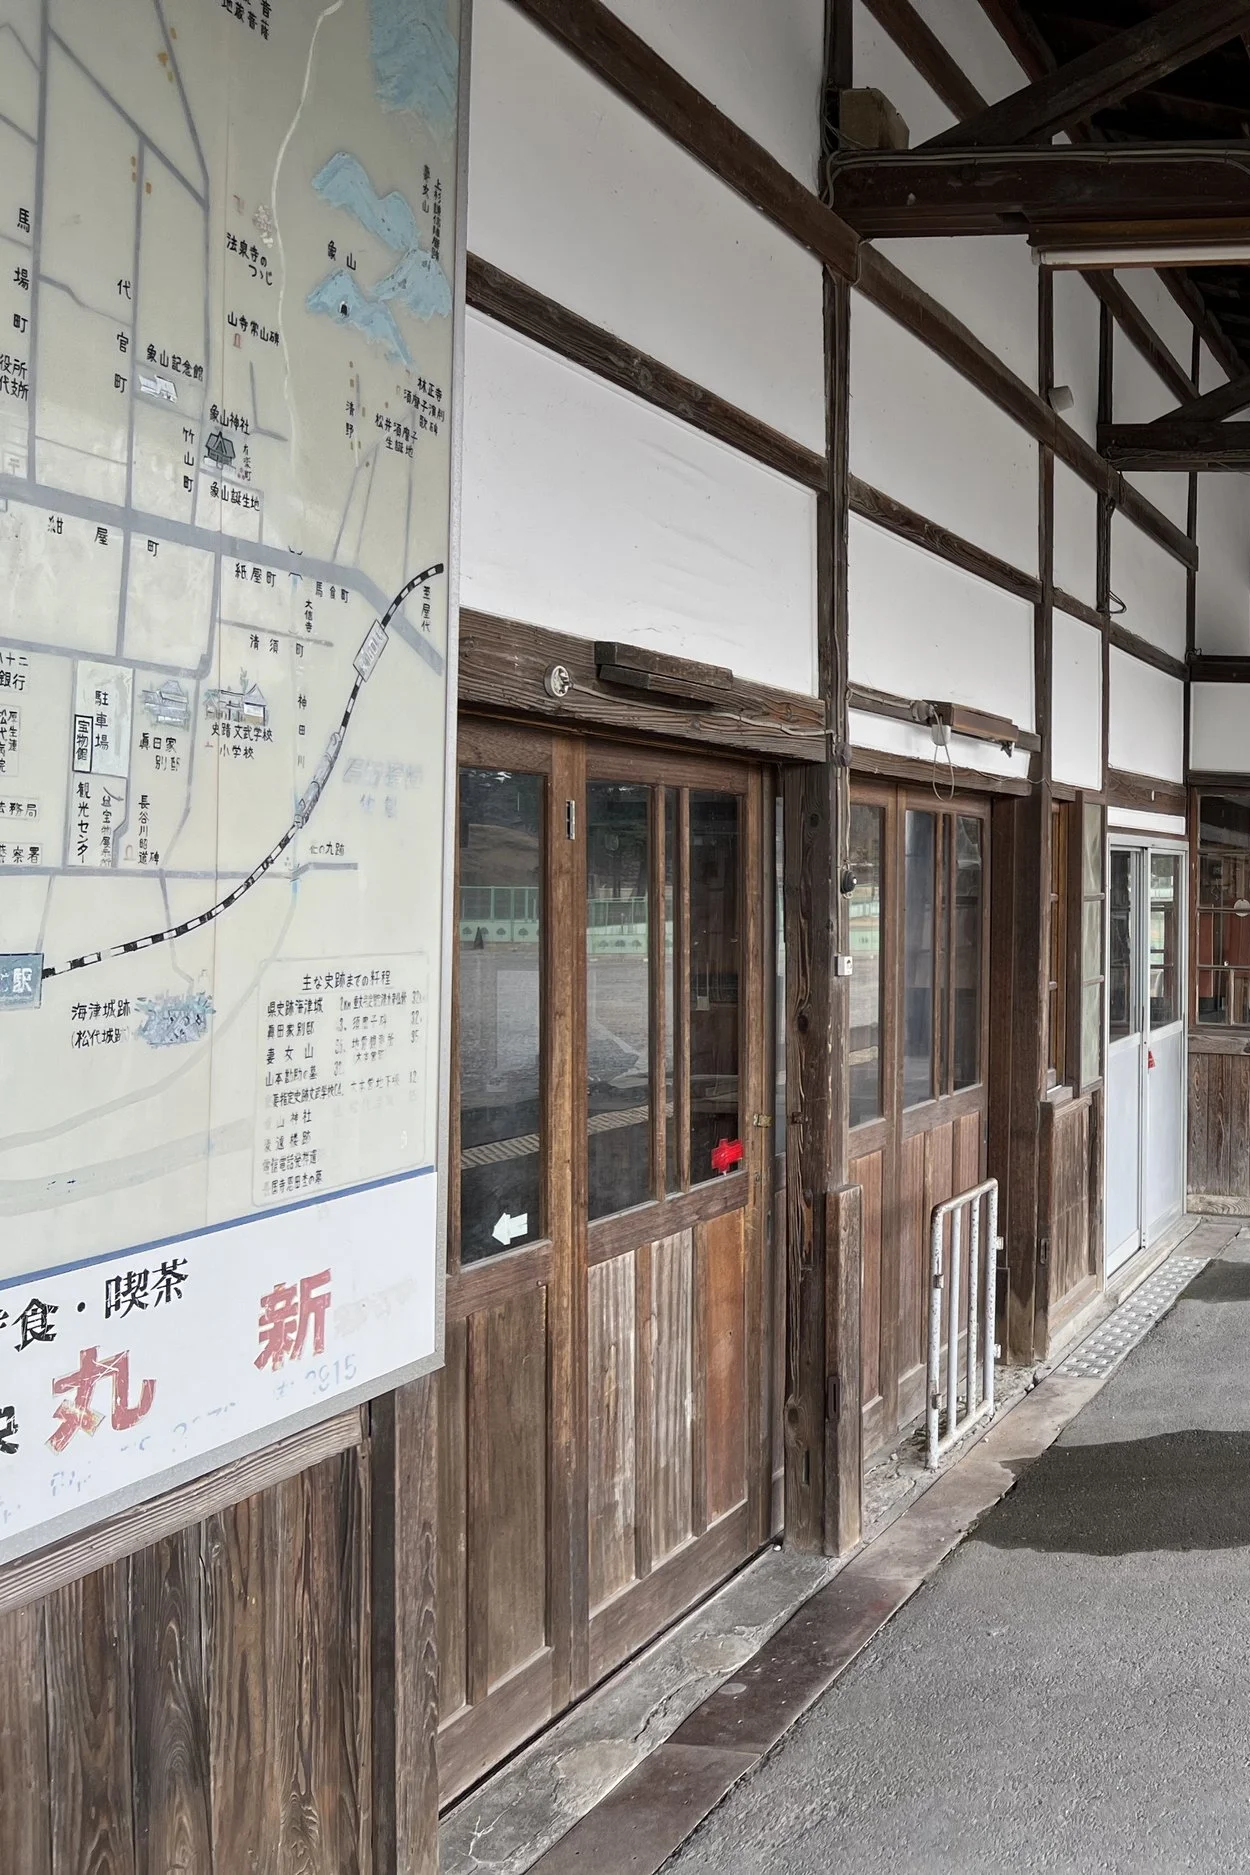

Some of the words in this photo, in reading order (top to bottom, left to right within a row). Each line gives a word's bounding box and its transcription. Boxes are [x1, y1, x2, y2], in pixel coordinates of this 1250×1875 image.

[226, 232, 267, 267] 法泉寺の
[13, 208, 31, 333] 馬場町
[114, 279, 132, 393] 代官町
[146, 343, 204, 382] 象山記念館
[210, 403, 250, 435] 象山神社
[182, 427, 195, 493] 竹山町
[210, 482, 261, 511] 象山誕生地
[76, 720, 91, 761] 宝物館
[94, 690, 109, 750] 駐車場
[219, 744, 255, 760] 小学校
[76, 782, 91, 864] 観光センター
[71, 999, 132, 1021] 海津城跡
[0, 1258, 190, 1352] 食・喫茶
